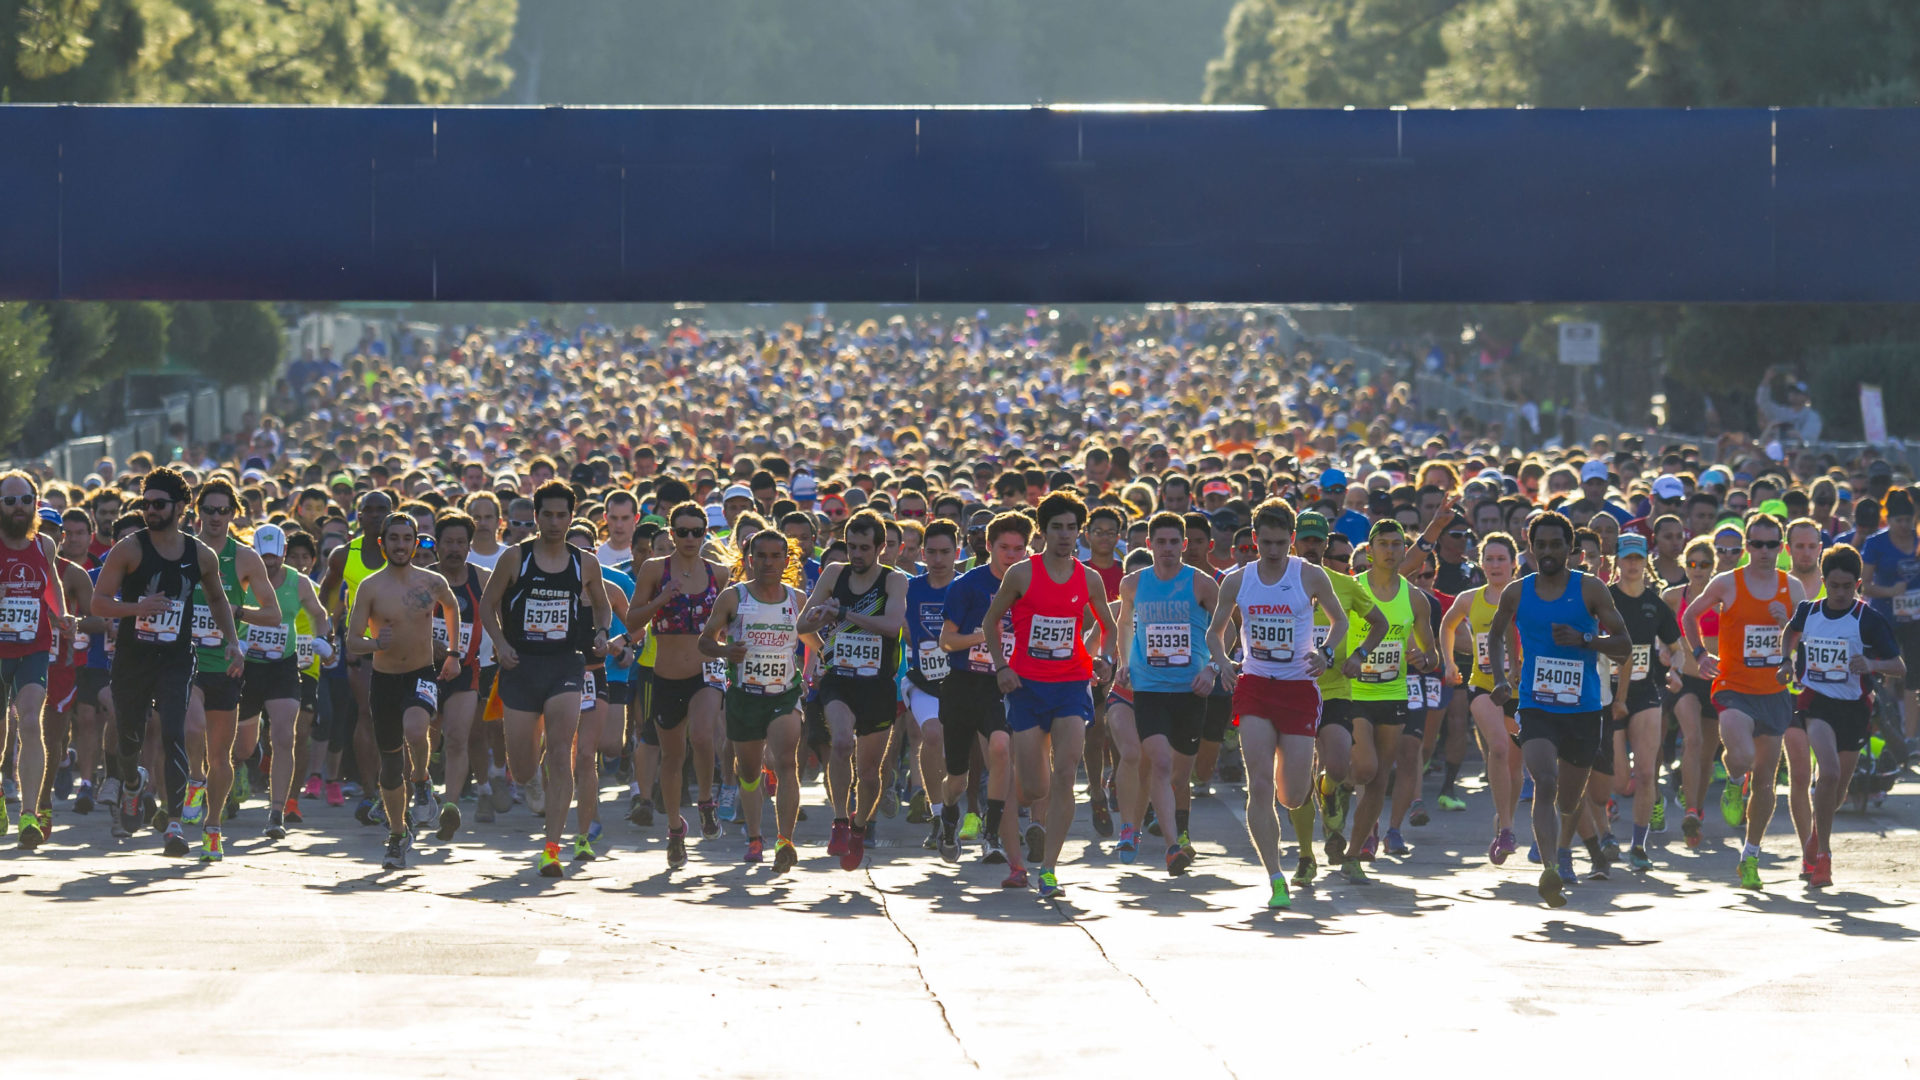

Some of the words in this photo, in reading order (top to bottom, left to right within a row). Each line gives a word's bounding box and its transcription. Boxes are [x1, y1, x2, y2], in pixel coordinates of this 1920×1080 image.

[531, 588, 571, 598] AGGIES
[0, 608, 38, 624] 53794
[527, 609, 568, 624] 53785
[1137, 600, 1190, 622] RECKLESS
[1248, 604, 1292, 615] STRAVA
[192, 615, 218, 630] 266
[249, 629, 287, 646] 52535
[747, 630, 790, 641] OCOTLÁN
[1033, 625, 1073, 642] 52579
[1148, 634, 1189, 648] 53339
[1251, 624, 1293, 643] 53801
[753, 639, 785, 647] JALISCO
[836, 643, 880, 660] 53458
[1808, 646, 1848, 664] 51674
[745, 661, 786, 677] 54263
[1537, 667, 1581, 686] 54009
